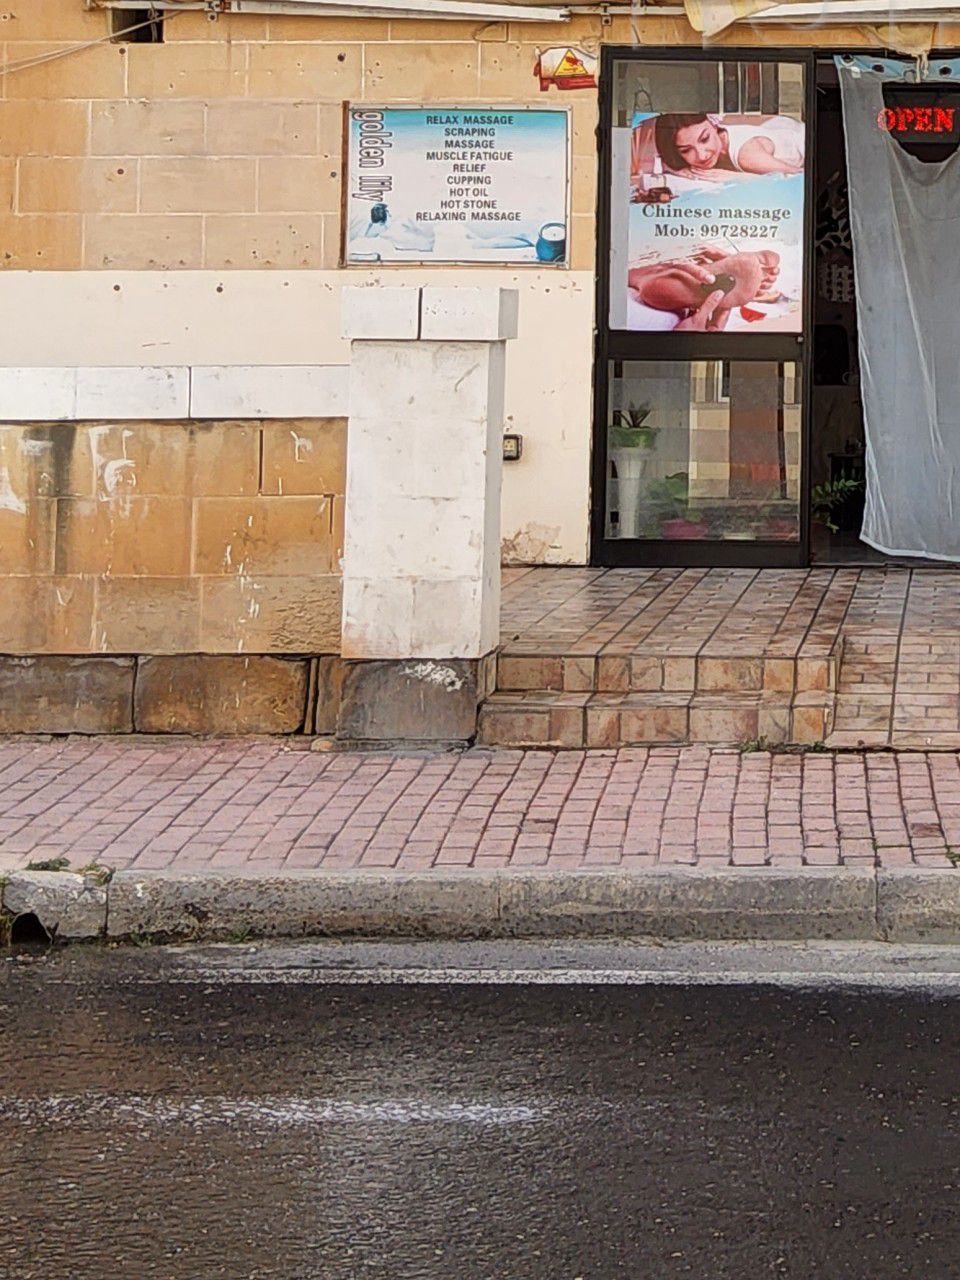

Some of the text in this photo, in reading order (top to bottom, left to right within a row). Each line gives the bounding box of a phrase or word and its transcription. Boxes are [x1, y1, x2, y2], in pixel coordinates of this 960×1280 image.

[426, 115, 514, 126] RELAX MASSAGE
[877, 107, 956, 132] OPEN
[444, 127, 496, 138] SCRAPING
[444, 139, 496, 150] MASSAGE
[352, 110, 393, 202] golden lily
[426, 151, 513, 162] MUSCLE FATIGUE
[452, 163, 487, 173] RELIEF
[446, 175, 492, 186] CUPPING
[449, 187, 489, 198] HOT OIL
[440, 199, 498, 210] HOT STONE
[415, 211, 522, 222] RELAXING MASSAGE
[642, 204, 791, 221] Chinese massage
[654, 224, 779, 239] Mob: 99728227
